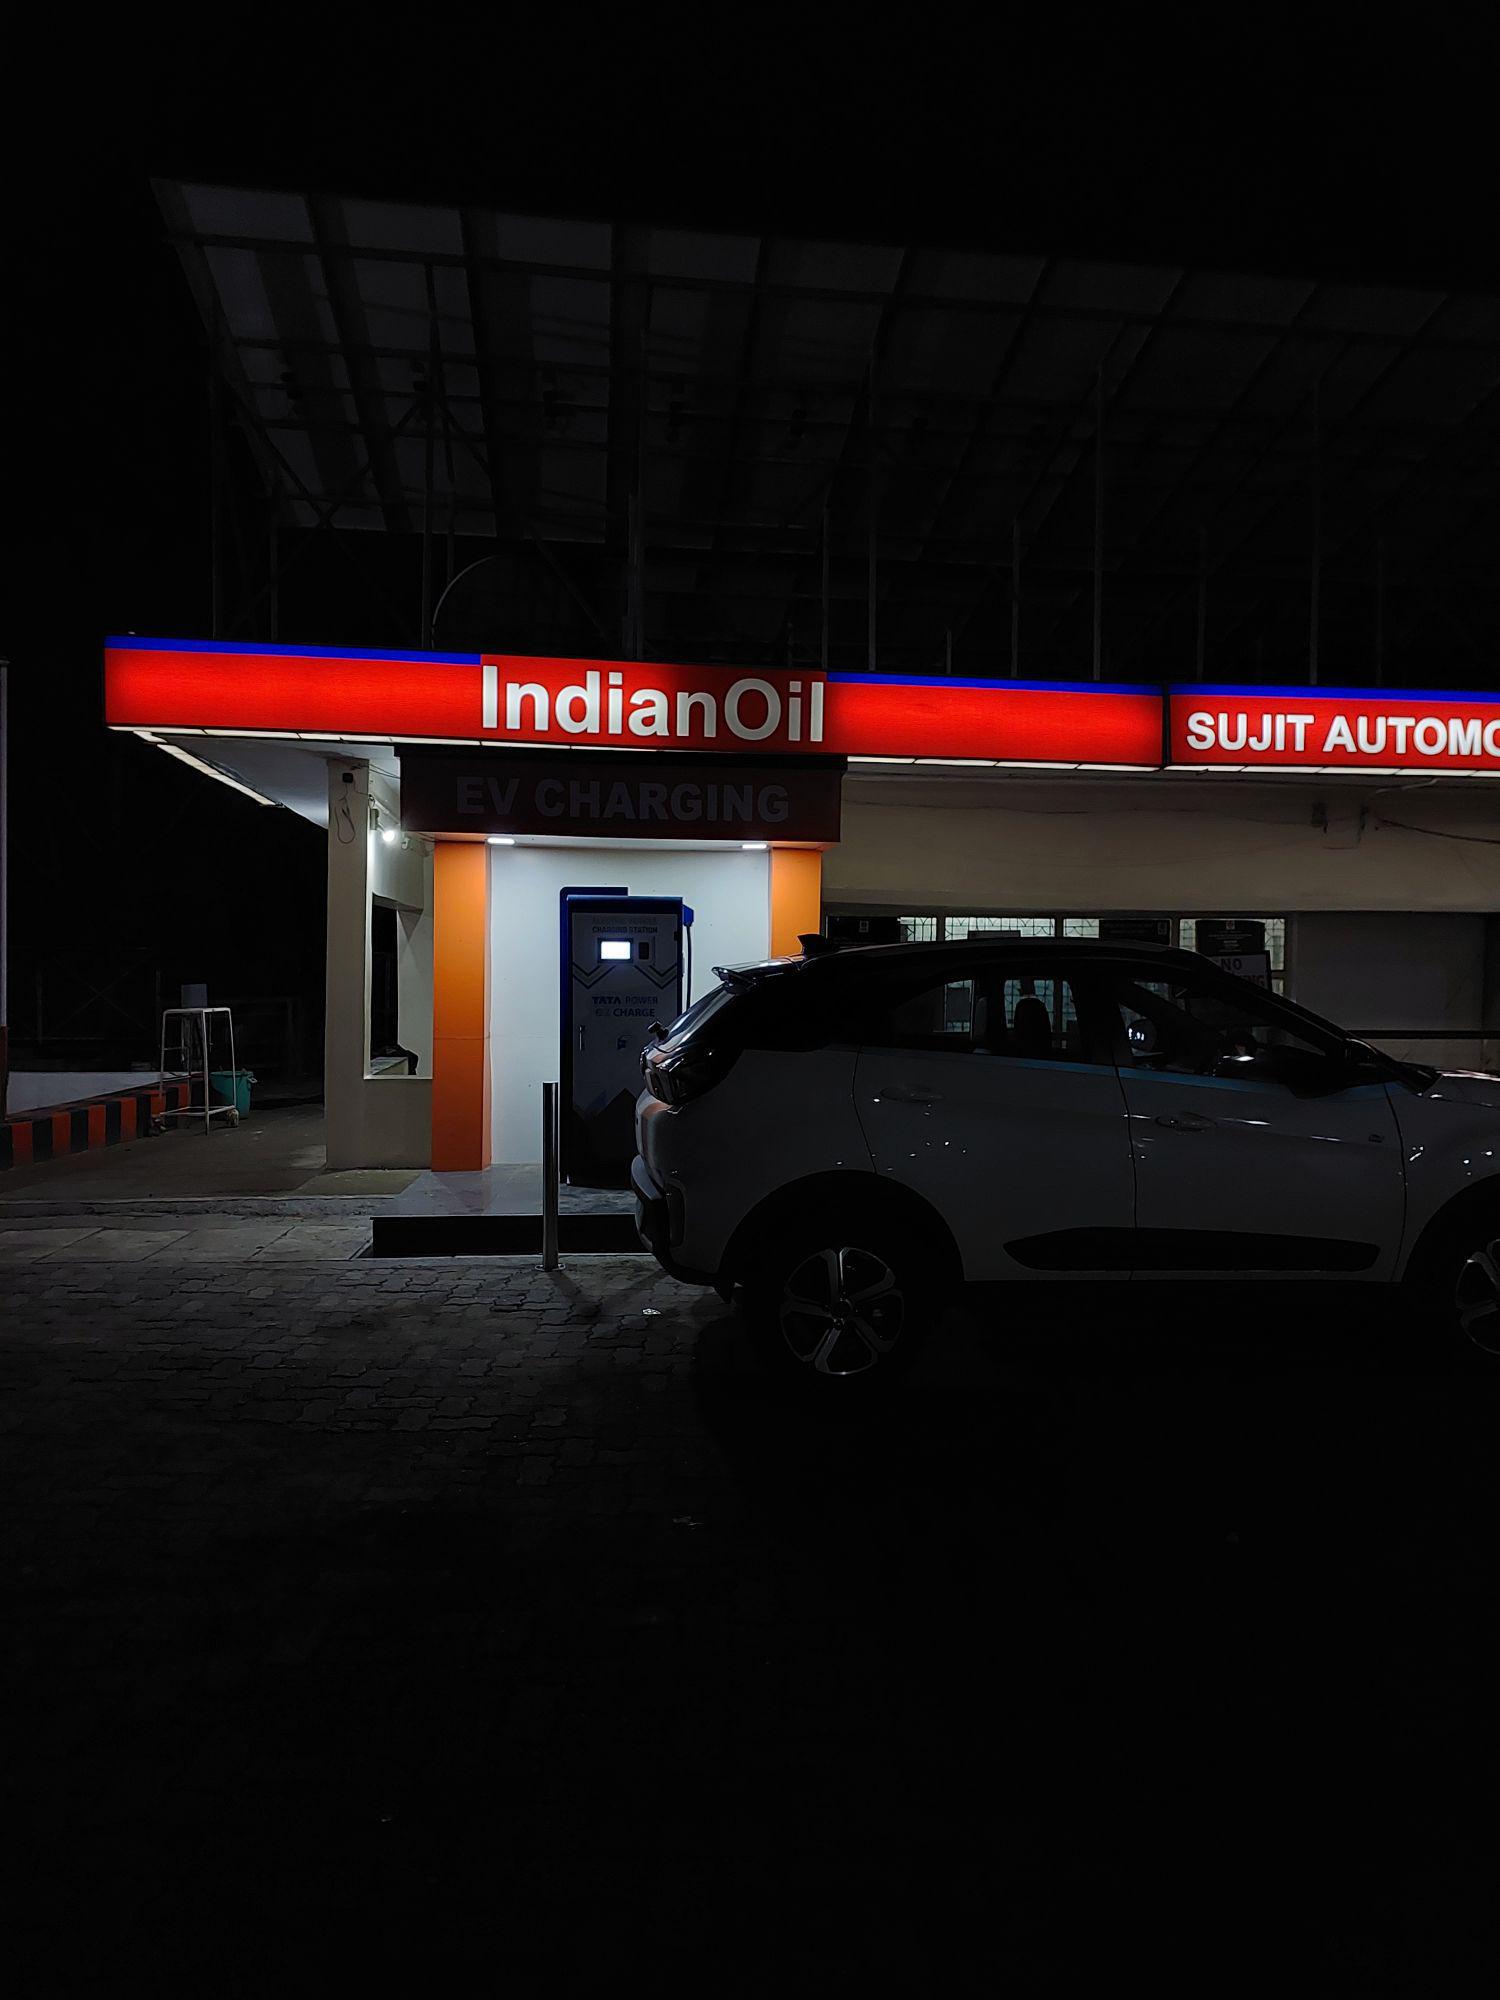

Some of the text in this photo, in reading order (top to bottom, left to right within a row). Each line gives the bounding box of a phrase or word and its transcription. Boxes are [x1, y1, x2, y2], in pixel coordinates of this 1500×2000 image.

[482, 665, 825, 743] IndianOil
[1186, 711, 1315, 752] SUJIT
[455, 776, 790, 823] EV CHARGING
[1220, 957, 1242, 971] NO
[592, 996, 658, 1005] TATA POWER
[613, 1008, 655, 1017] CHARGE
